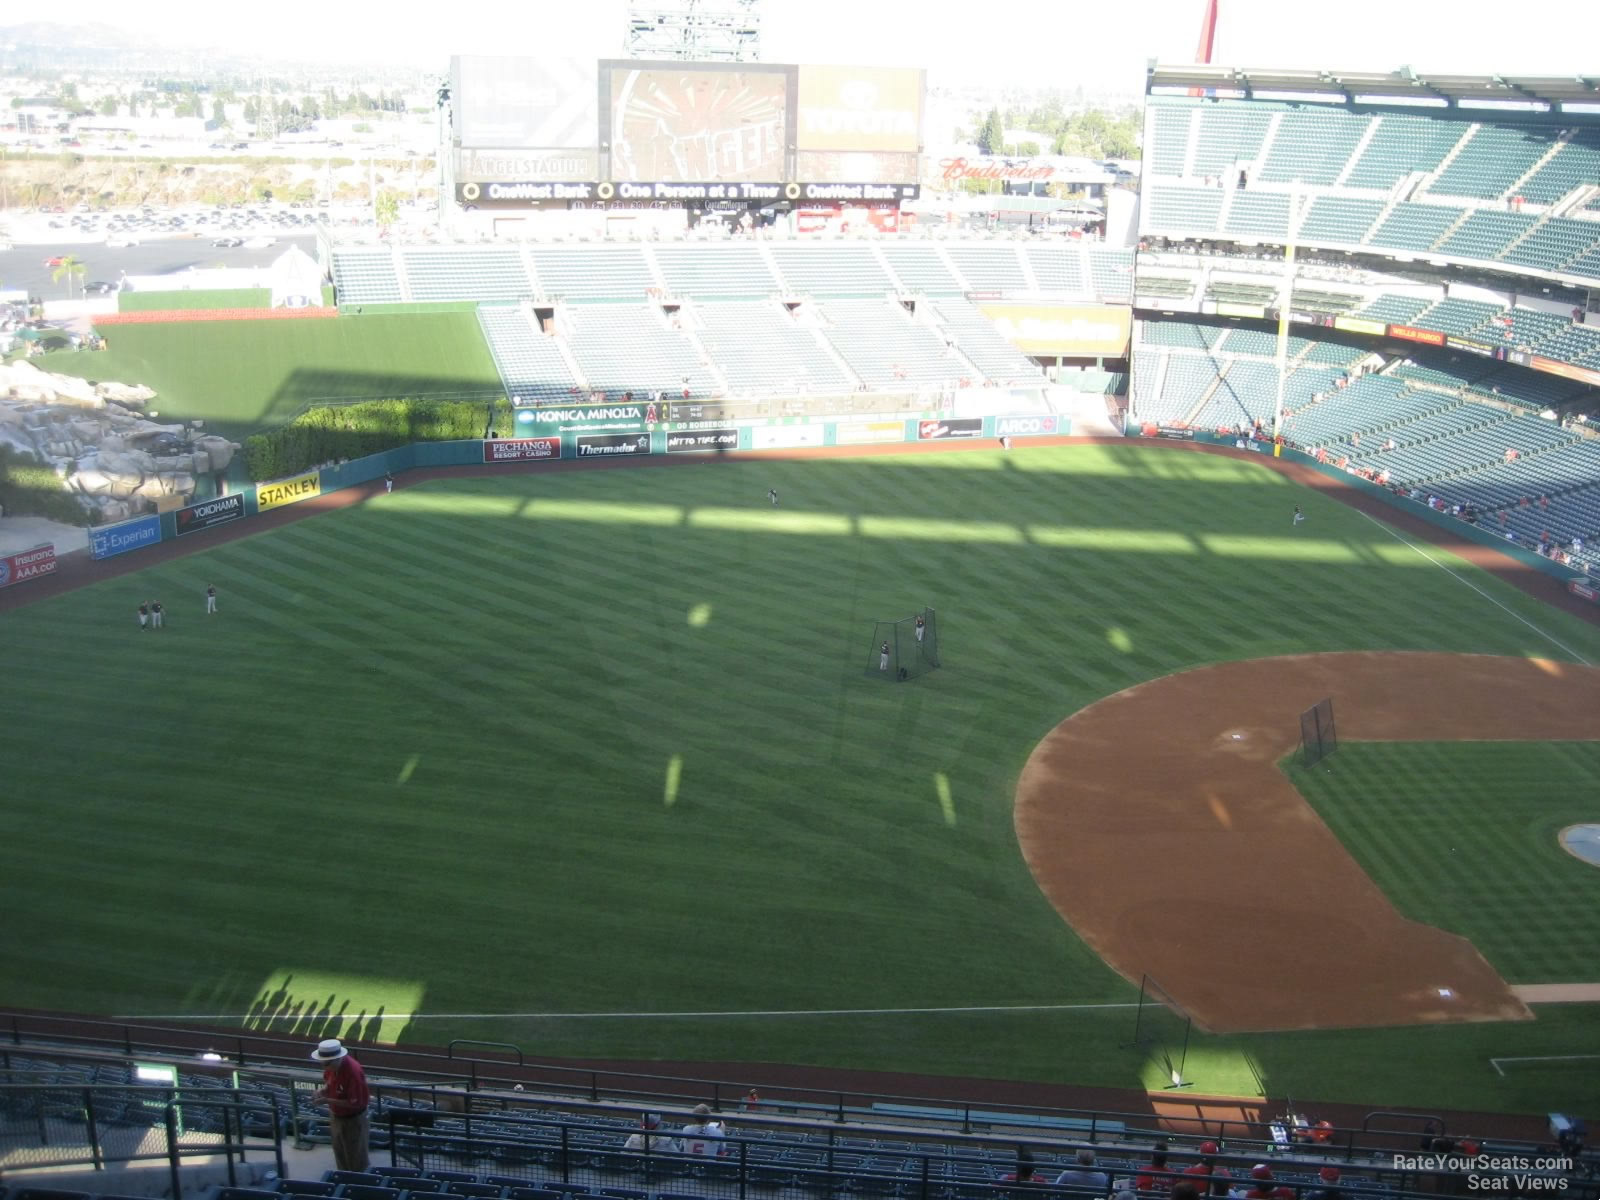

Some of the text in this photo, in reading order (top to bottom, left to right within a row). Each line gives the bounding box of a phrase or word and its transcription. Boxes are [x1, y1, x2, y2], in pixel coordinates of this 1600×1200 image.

[472, 159, 588, 175] ANGEL STADIUM
[939, 157, 1056, 180] Budweiser
[489, 184, 591, 199] OneWest Bank
[620, 183, 779, 198] One Person at a Time
[807, 184, 862, 198] OneWest
[864, 185, 897, 198] Bank
[1392, 328, 1442, 343] WELLS FARGO
[536, 407, 642, 423] KONICA MINOLTA
[999, 419, 1041, 434] ARCO
[493, 441, 553, 452] PECHANGA
[579, 443, 637, 455] Thermador
[668, 437, 695, 447] NITTO
[258, 478, 319, 506] STANLEY
[194, 498, 240, 518] YOKOHAMA
[111, 527, 155, 547] Experian
[15, 549, 55, 566] Insuranc
